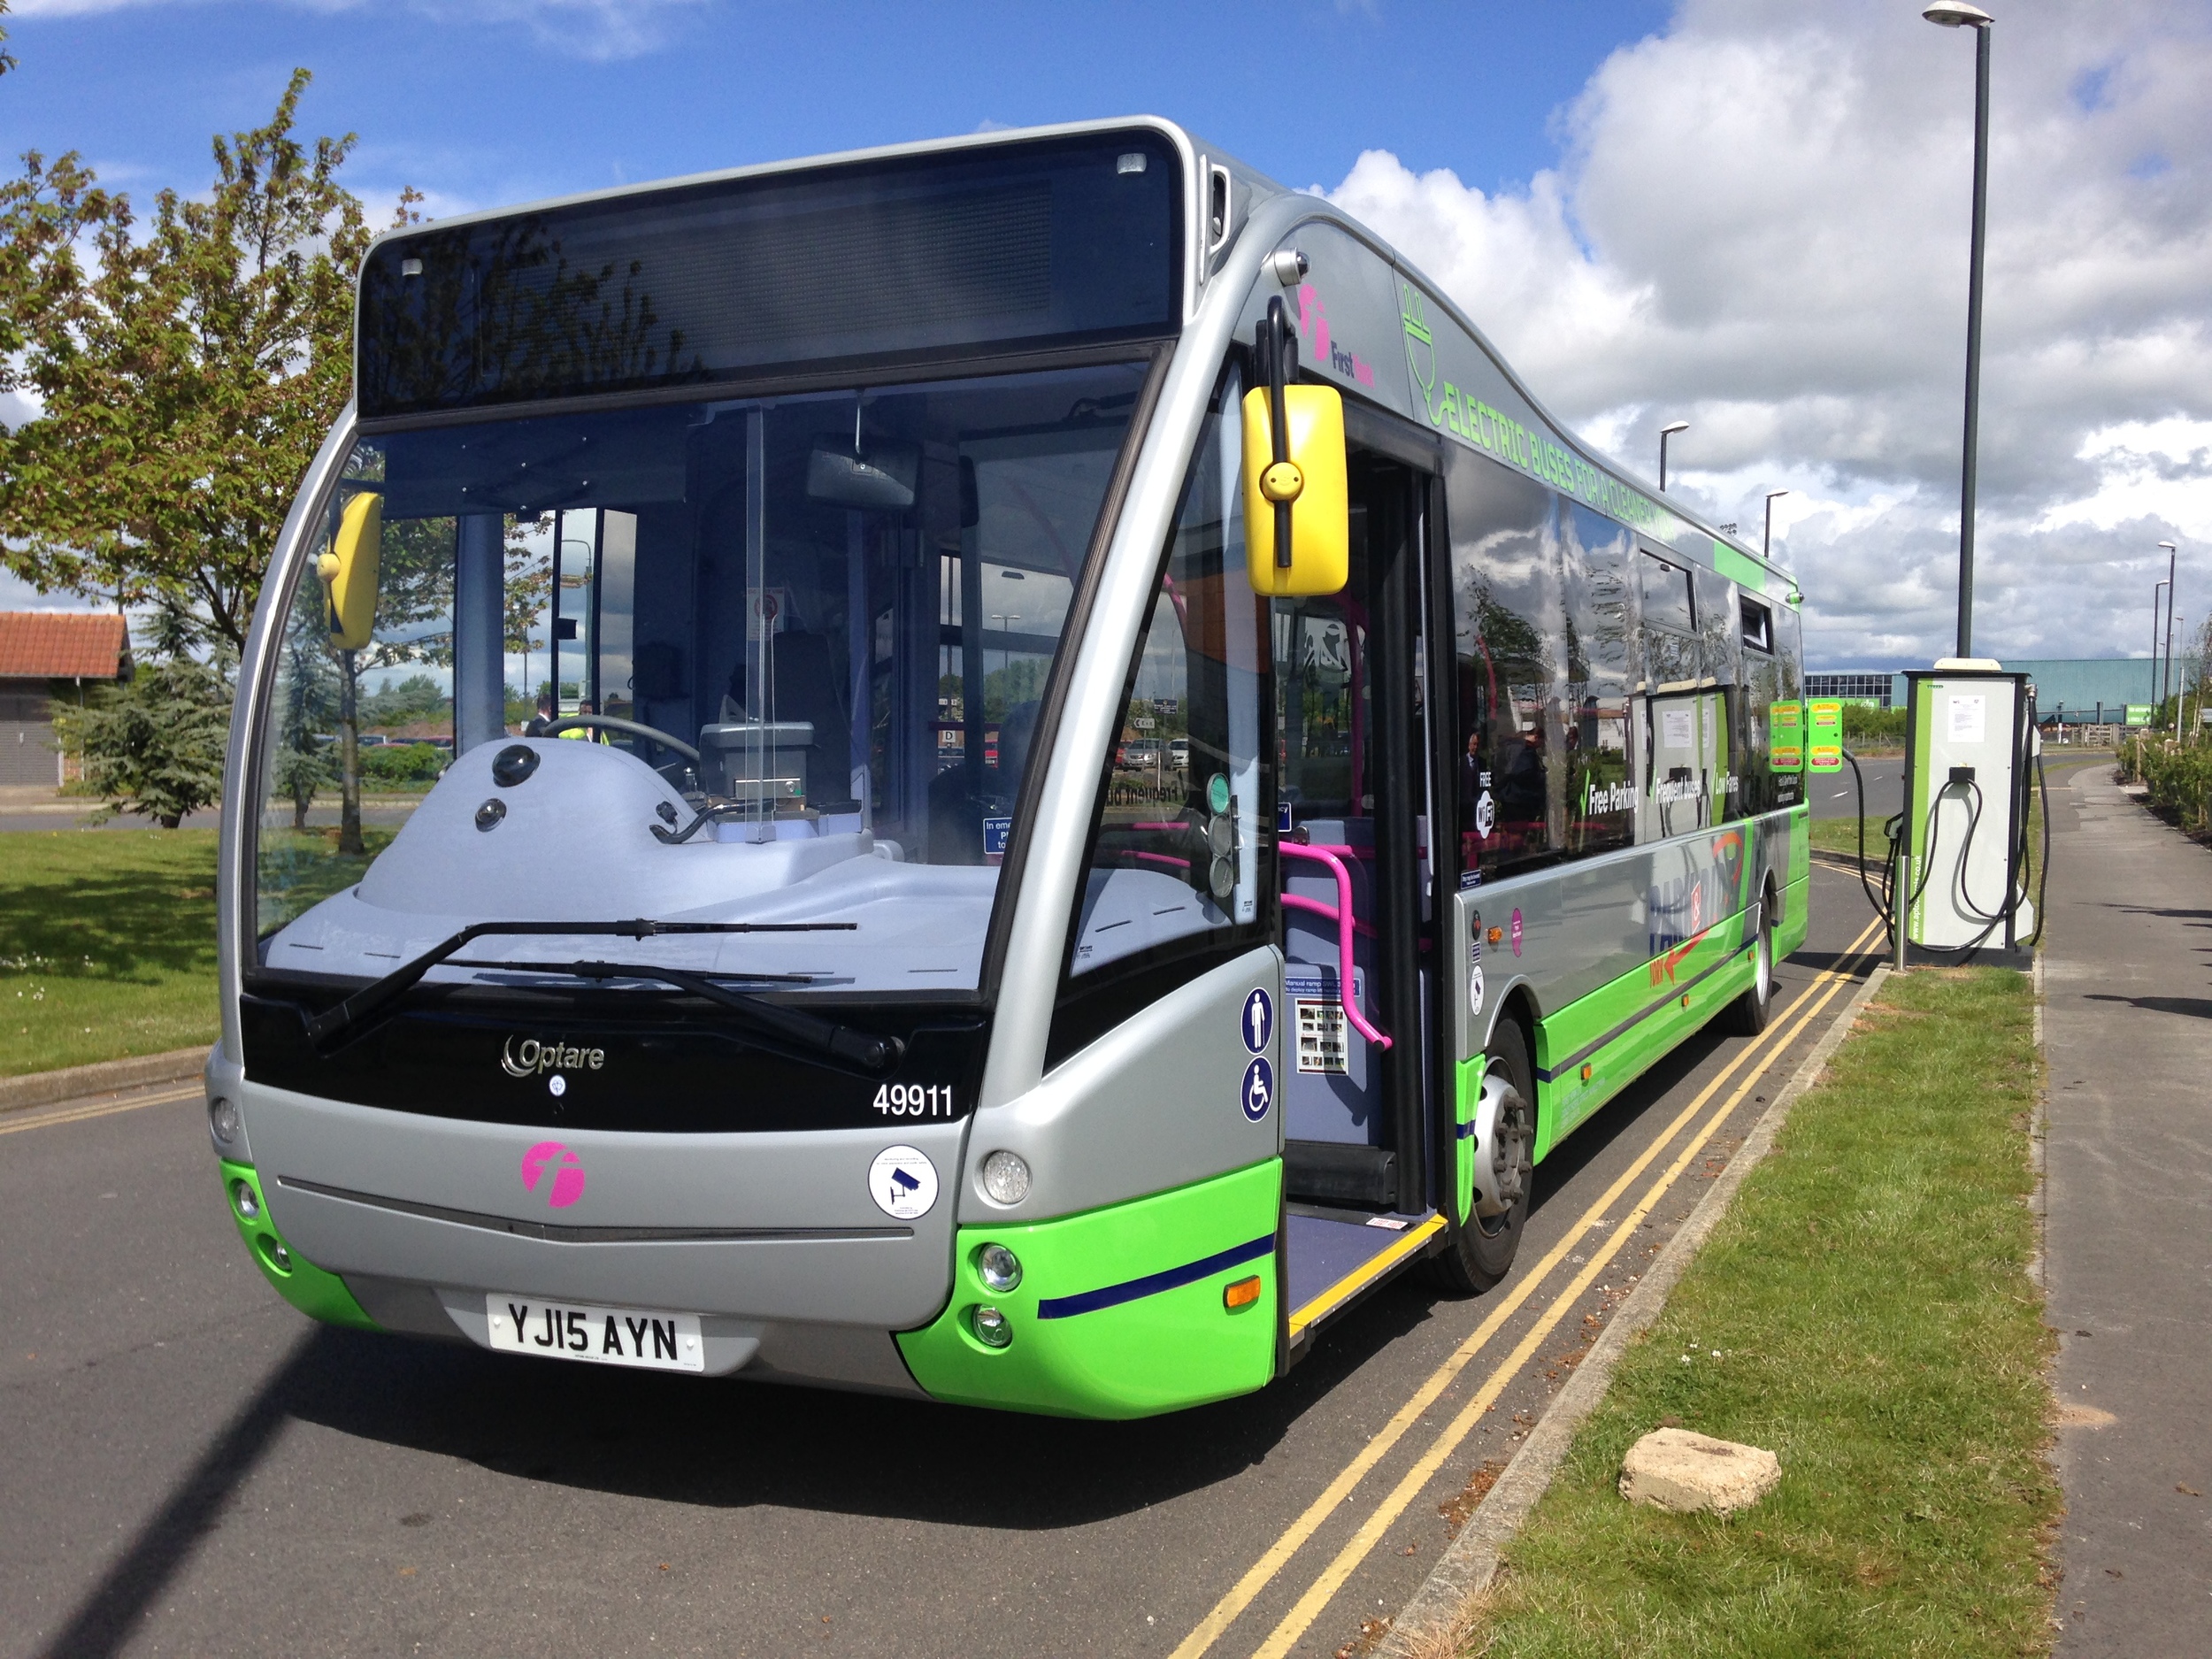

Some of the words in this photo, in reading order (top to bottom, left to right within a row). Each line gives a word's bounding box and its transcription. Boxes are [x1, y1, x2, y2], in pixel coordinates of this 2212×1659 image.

[1331, 340, 1355, 379] First
[1443, 381, 1528, 469] ELECTRIC
[1529, 431, 1575, 494] BUSES
[1574, 458, 1601, 506] FOR
[1601, 473, 1610, 511] A
[1609, 479, 1651, 531] CLEANER
[945, 731, 953, 741] D
[1479, 772, 1492, 787] FREE
[1655, 778, 1684, 807] Frequent
[1684, 775, 1701, 800] buses
[1716, 772, 1726, 795] Low
[1726, 771, 1739, 794] Fares
[1589, 784, 1609, 815] Free
[1609, 780, 1640, 814] Parking
[986, 821, 995, 830] In
[997, 841, 1006, 849] to
[519, 1039, 605, 1074] Optare
[872, 1084, 951, 1117] 49911
[508, 1302, 588, 1352] YJ15
[603, 1315, 678, 1361] AYN
